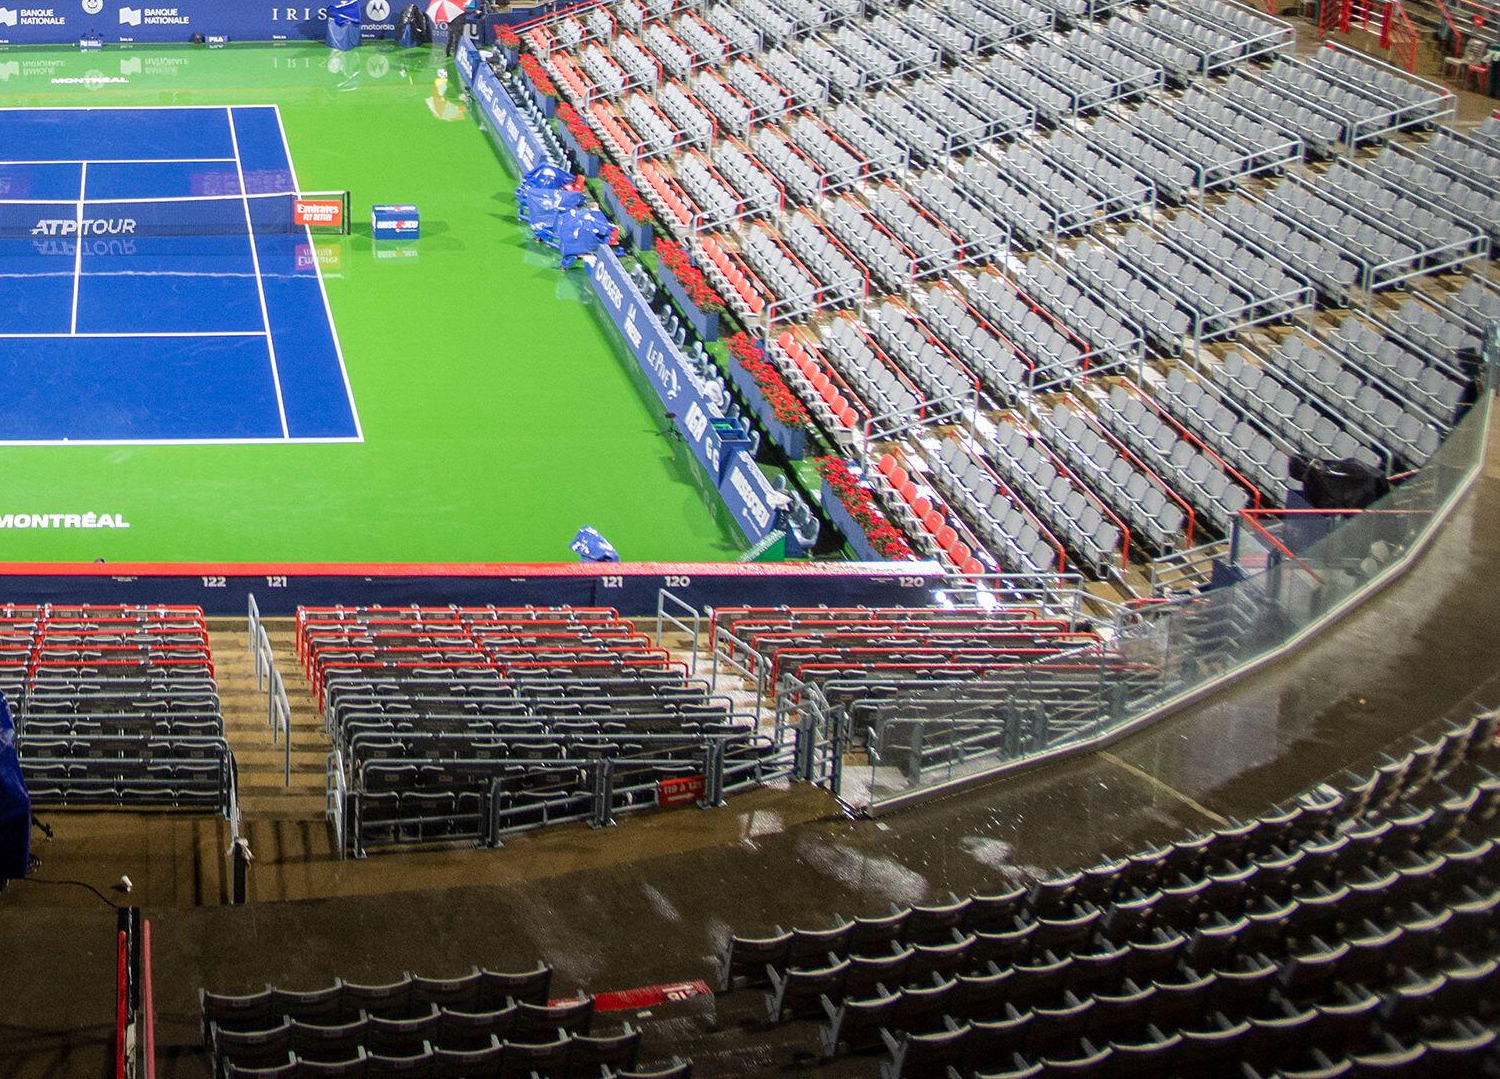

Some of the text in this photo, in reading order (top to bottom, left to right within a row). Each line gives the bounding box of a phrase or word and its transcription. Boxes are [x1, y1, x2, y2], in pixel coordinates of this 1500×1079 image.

[20, 8, 54, 17] BANQUE
[144, 8, 178, 16] BANQUE
[272, 7, 328, 21] IRIS
[20, 16, 65, 25] NATIONALE
[144, 16, 190, 25] NATIONALE
[297, 204, 339, 213] Emirates
[29, 219, 137, 235] ATP TOUR
[202, 576, 226, 587] 122
[266, 576, 287, 587] 121
[602, 576, 623, 587] 121
[665, 576, 690, 587] 120
[898, 576, 925, 587] 120
